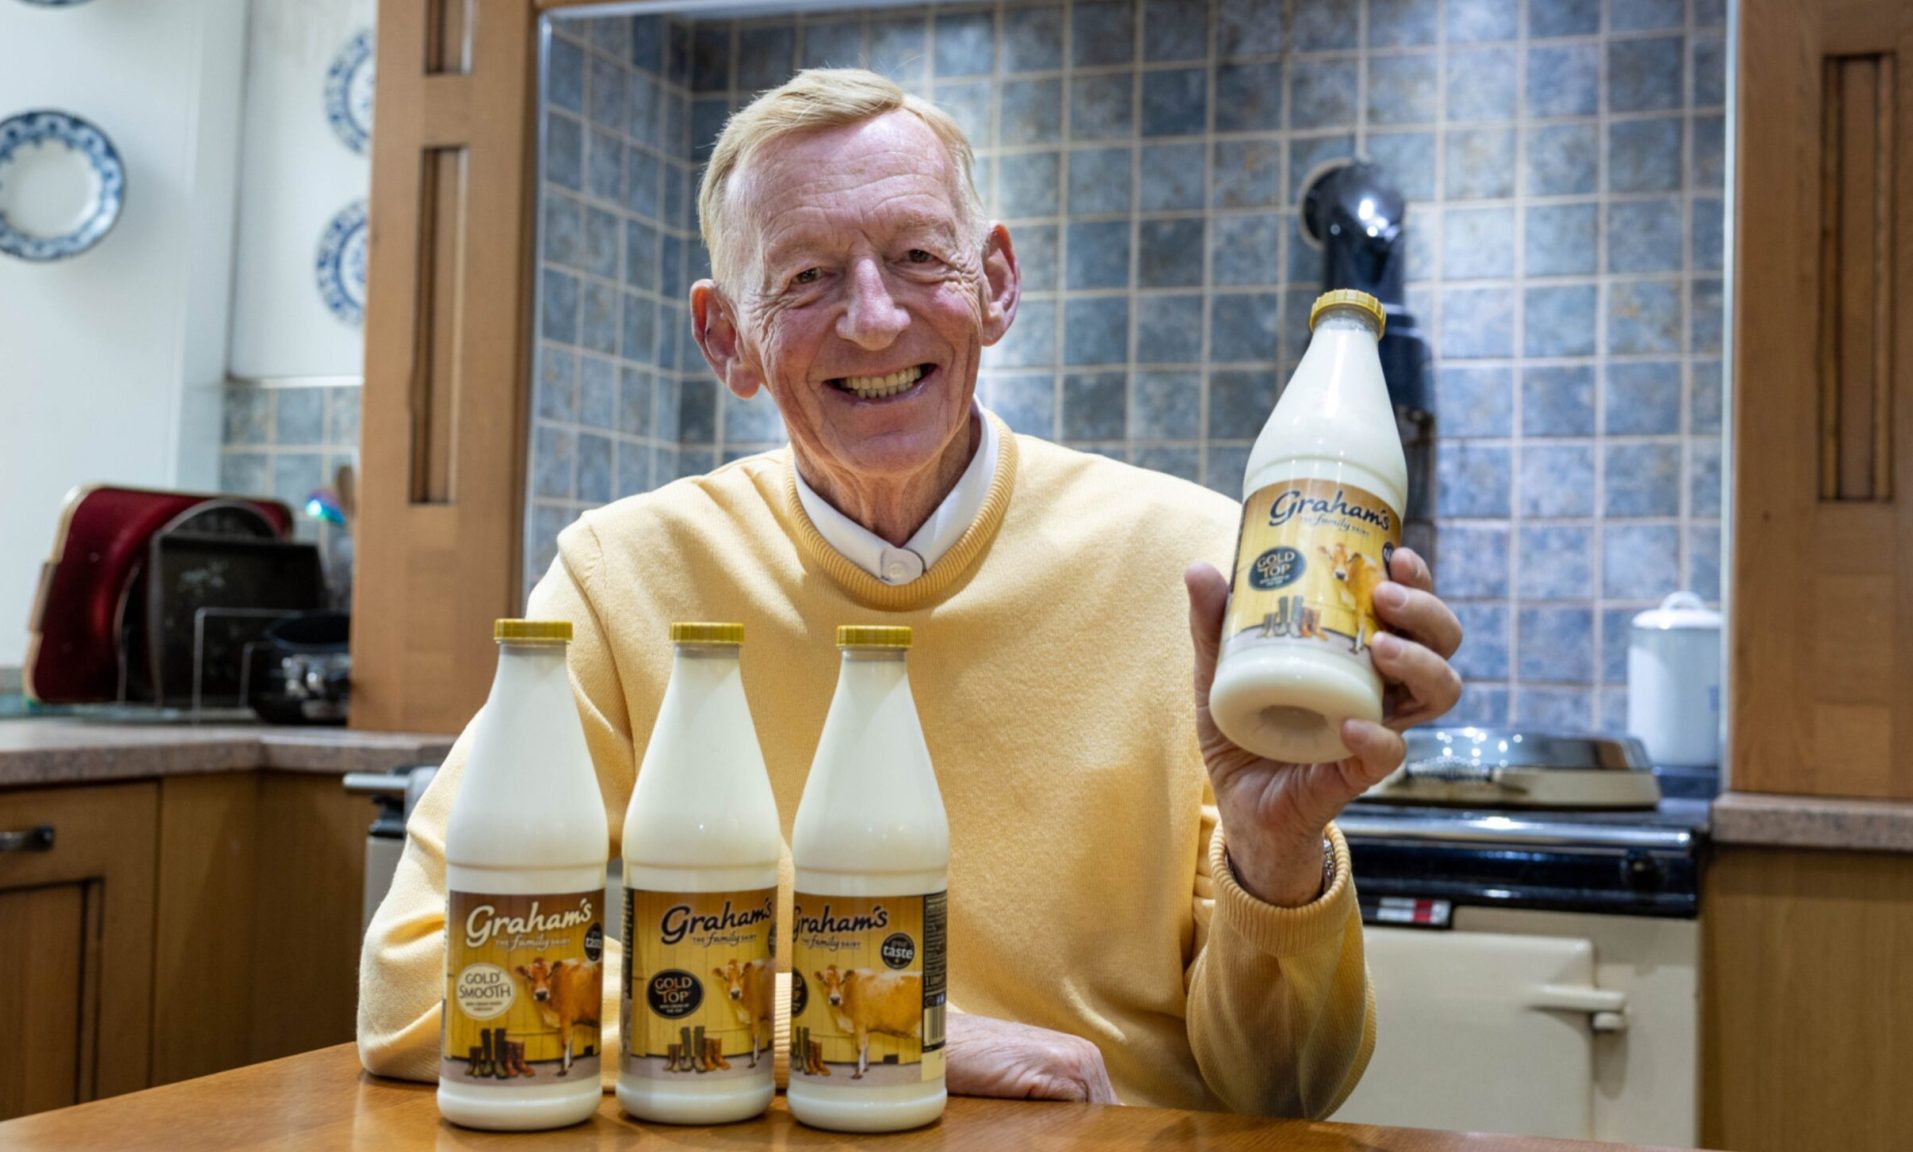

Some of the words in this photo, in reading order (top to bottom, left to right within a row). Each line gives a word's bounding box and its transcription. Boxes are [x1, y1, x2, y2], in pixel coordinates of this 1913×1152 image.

[1269, 490, 1391, 531] Graham's
[1312, 513, 1351, 533] family
[1257, 551, 1295, 569] GOLD
[1258, 563, 1291, 578] TOP
[466, 898, 593, 948] Graham's
[661, 898, 773, 945] Graham's
[508, 934, 551, 952] family
[703, 930, 740, 948] family
[808, 934, 840, 952] family
[883, 945, 914, 960] taste
[465, 972, 501, 985] GOLD
[654, 976, 693, 989] GOLD
[459, 984, 511, 1000] SMOOTH
[655, 989, 690, 1003] TOP
